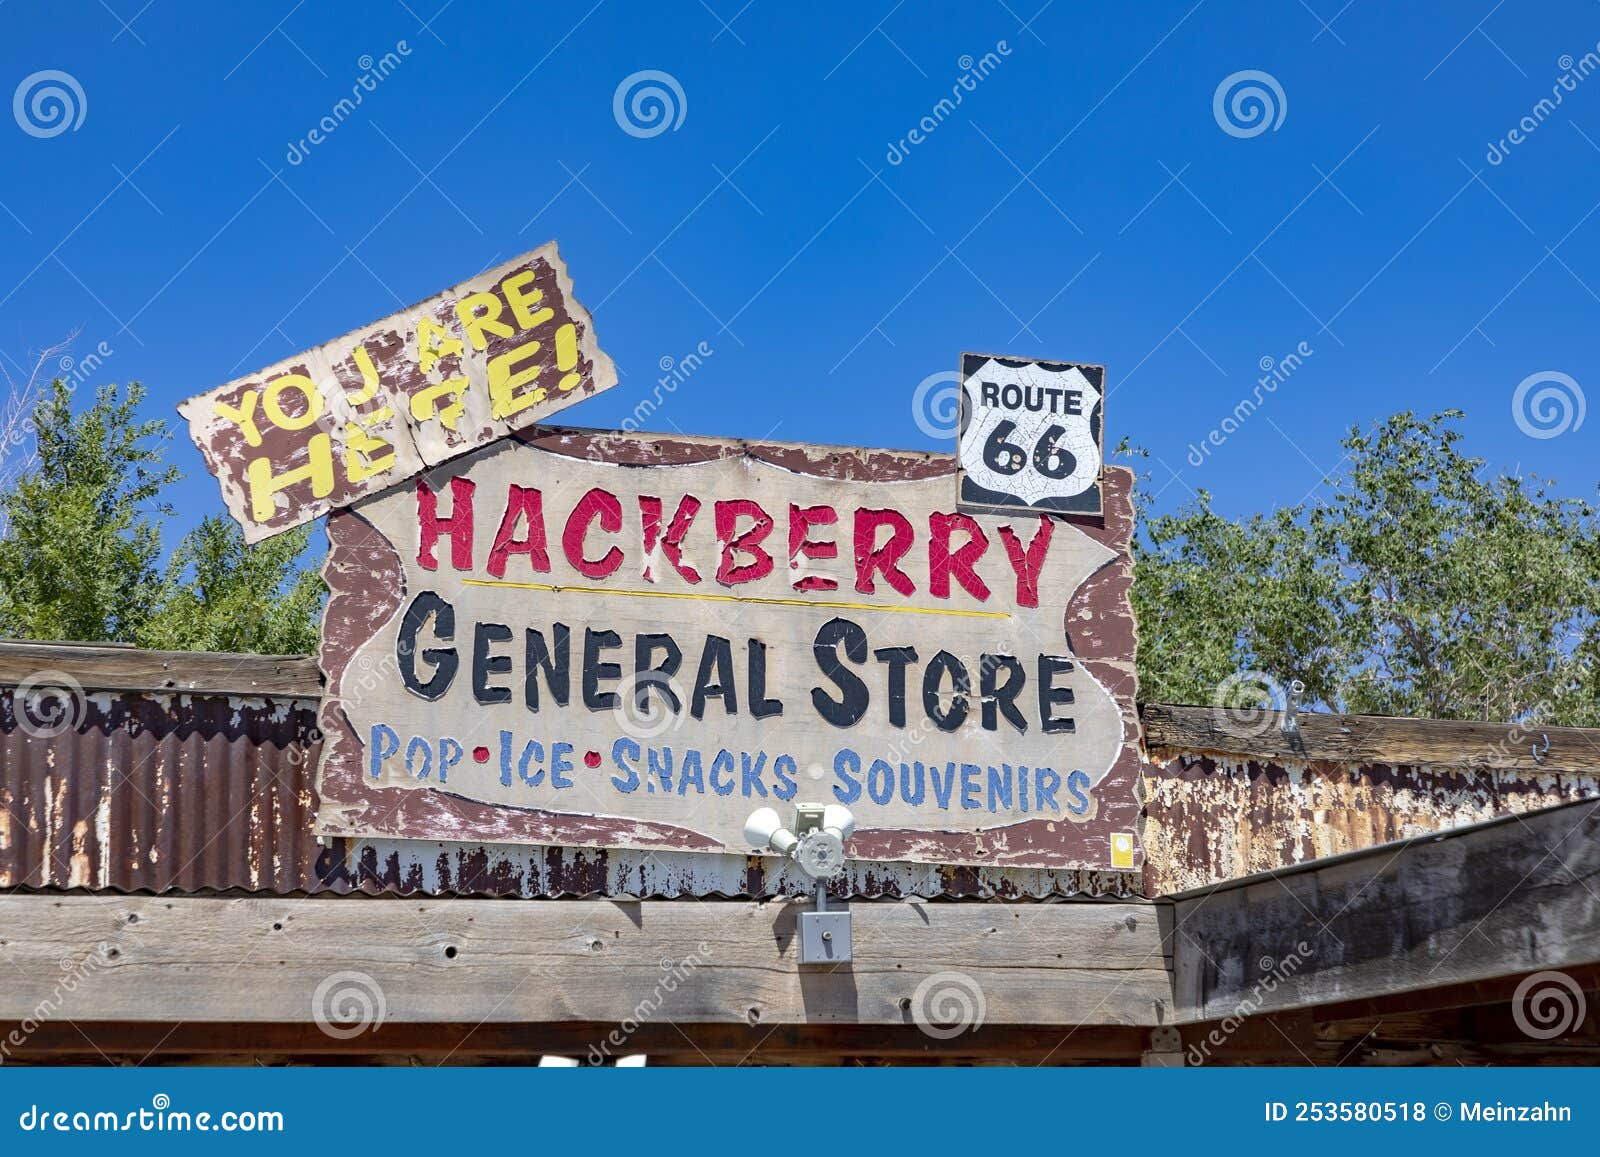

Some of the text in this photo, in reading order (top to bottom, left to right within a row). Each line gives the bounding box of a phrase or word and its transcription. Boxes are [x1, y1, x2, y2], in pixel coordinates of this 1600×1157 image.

[416, 269, 555, 374] ARE
[980, 381, 1083, 416] ROUTE
[982, 419, 1077, 480] 66
[415, 475, 1055, 608] HACKBERRY
[397, 590, 1076, 735] GENERAL STORE
[370, 723, 1091, 814] POP ICE SNACKS SOUVENIRS
